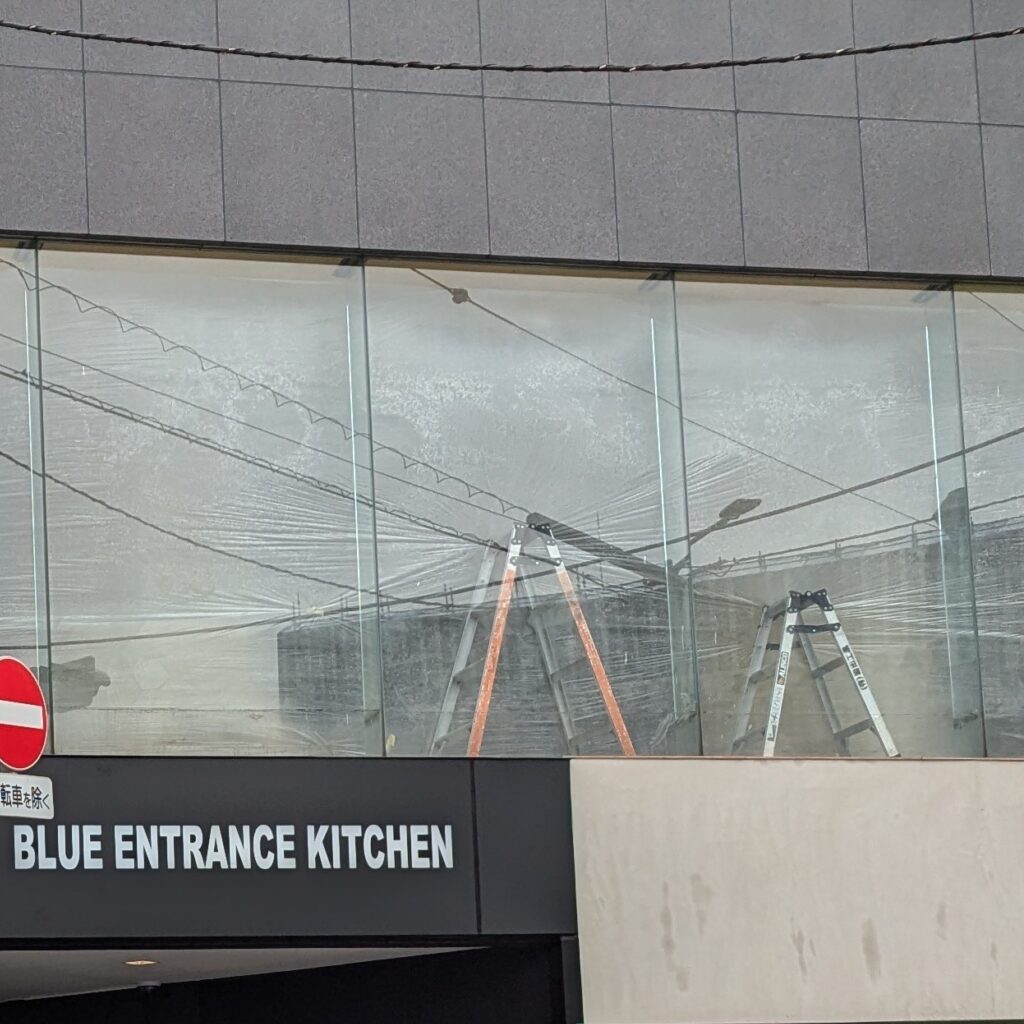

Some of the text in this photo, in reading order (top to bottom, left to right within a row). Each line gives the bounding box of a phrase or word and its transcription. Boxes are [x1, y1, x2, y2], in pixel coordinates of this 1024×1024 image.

[13, 824, 454, 869] BLUE ENTRANCE KITCHEN
